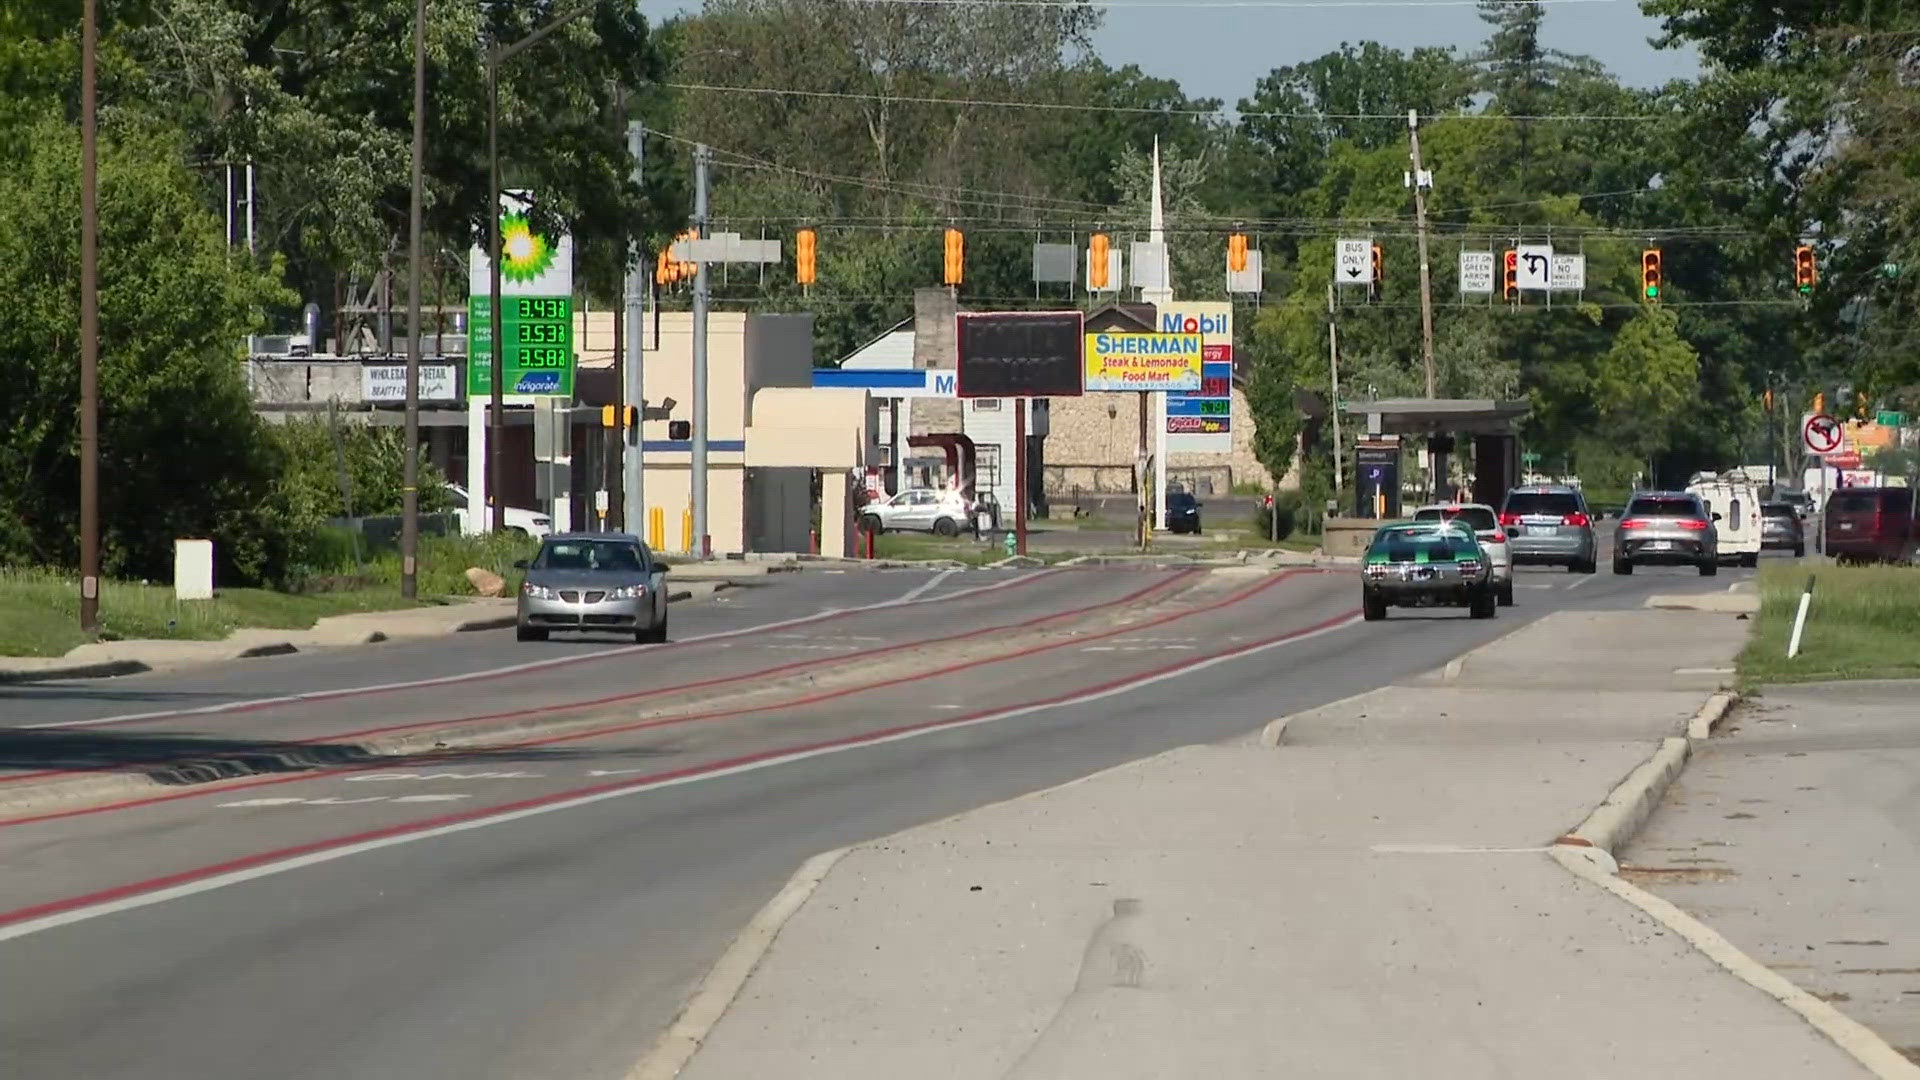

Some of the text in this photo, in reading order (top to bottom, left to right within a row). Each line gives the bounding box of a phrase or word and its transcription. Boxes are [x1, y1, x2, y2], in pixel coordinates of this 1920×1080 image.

[1345, 243, 1363, 252] BUS
[1342, 256, 1365, 264] ONLY
[1463, 255, 1479, 263] LEFT
[1558, 264, 1571, 273] NO
[1467, 281, 1486, 289] ONLY
[1163, 313, 1227, 334] Mobil
[1103, 357, 1188, 367] Steak & Lemonade
[370, 368, 406, 380] WHOLESA
[1122, 371, 1169, 381] Food Mart
